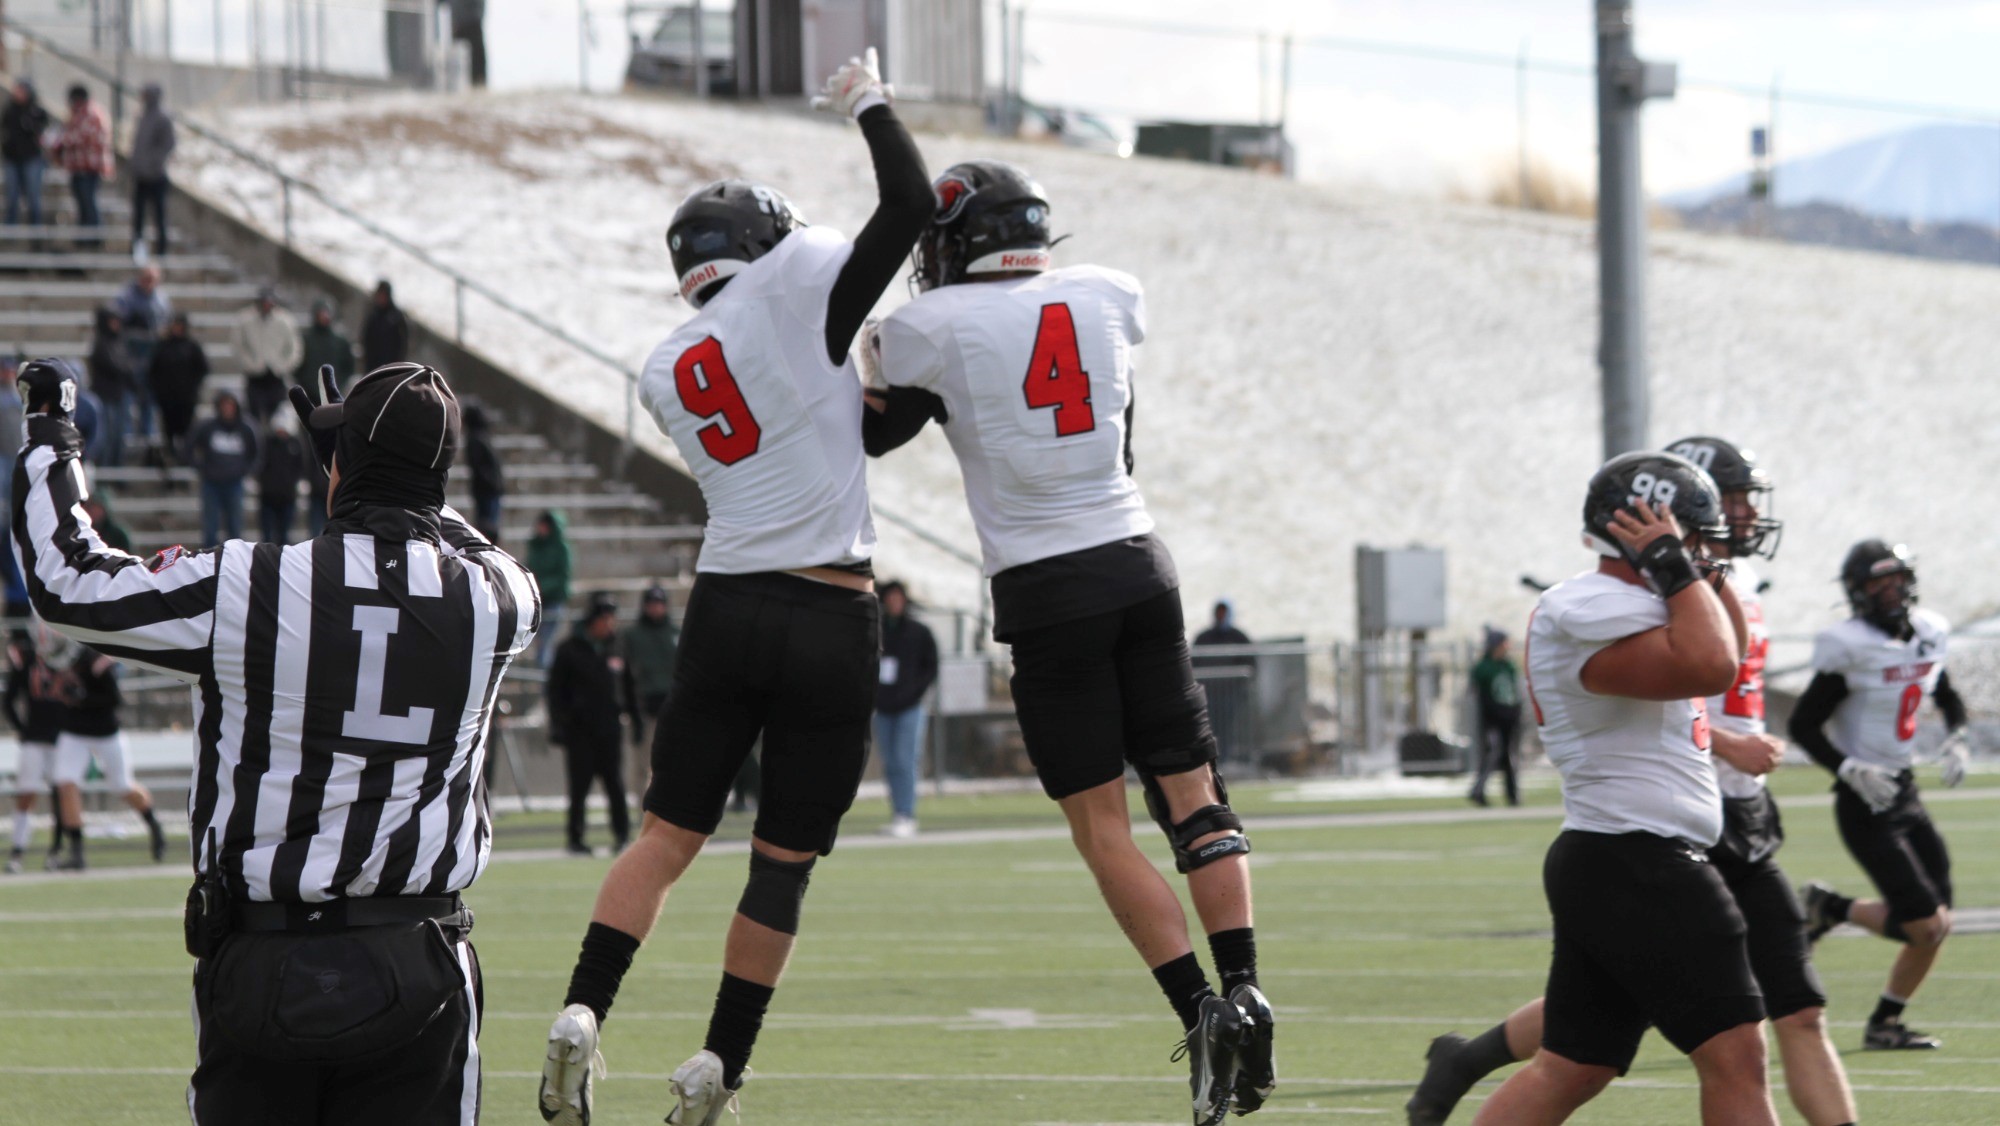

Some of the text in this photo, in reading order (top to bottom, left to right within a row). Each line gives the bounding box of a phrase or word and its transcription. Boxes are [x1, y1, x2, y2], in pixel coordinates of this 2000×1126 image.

[673, 335, 762, 466] 9
[1022, 302, 1095, 437] 4
[1627, 473, 1678, 514] 99
[341, 604, 435, 745] L
